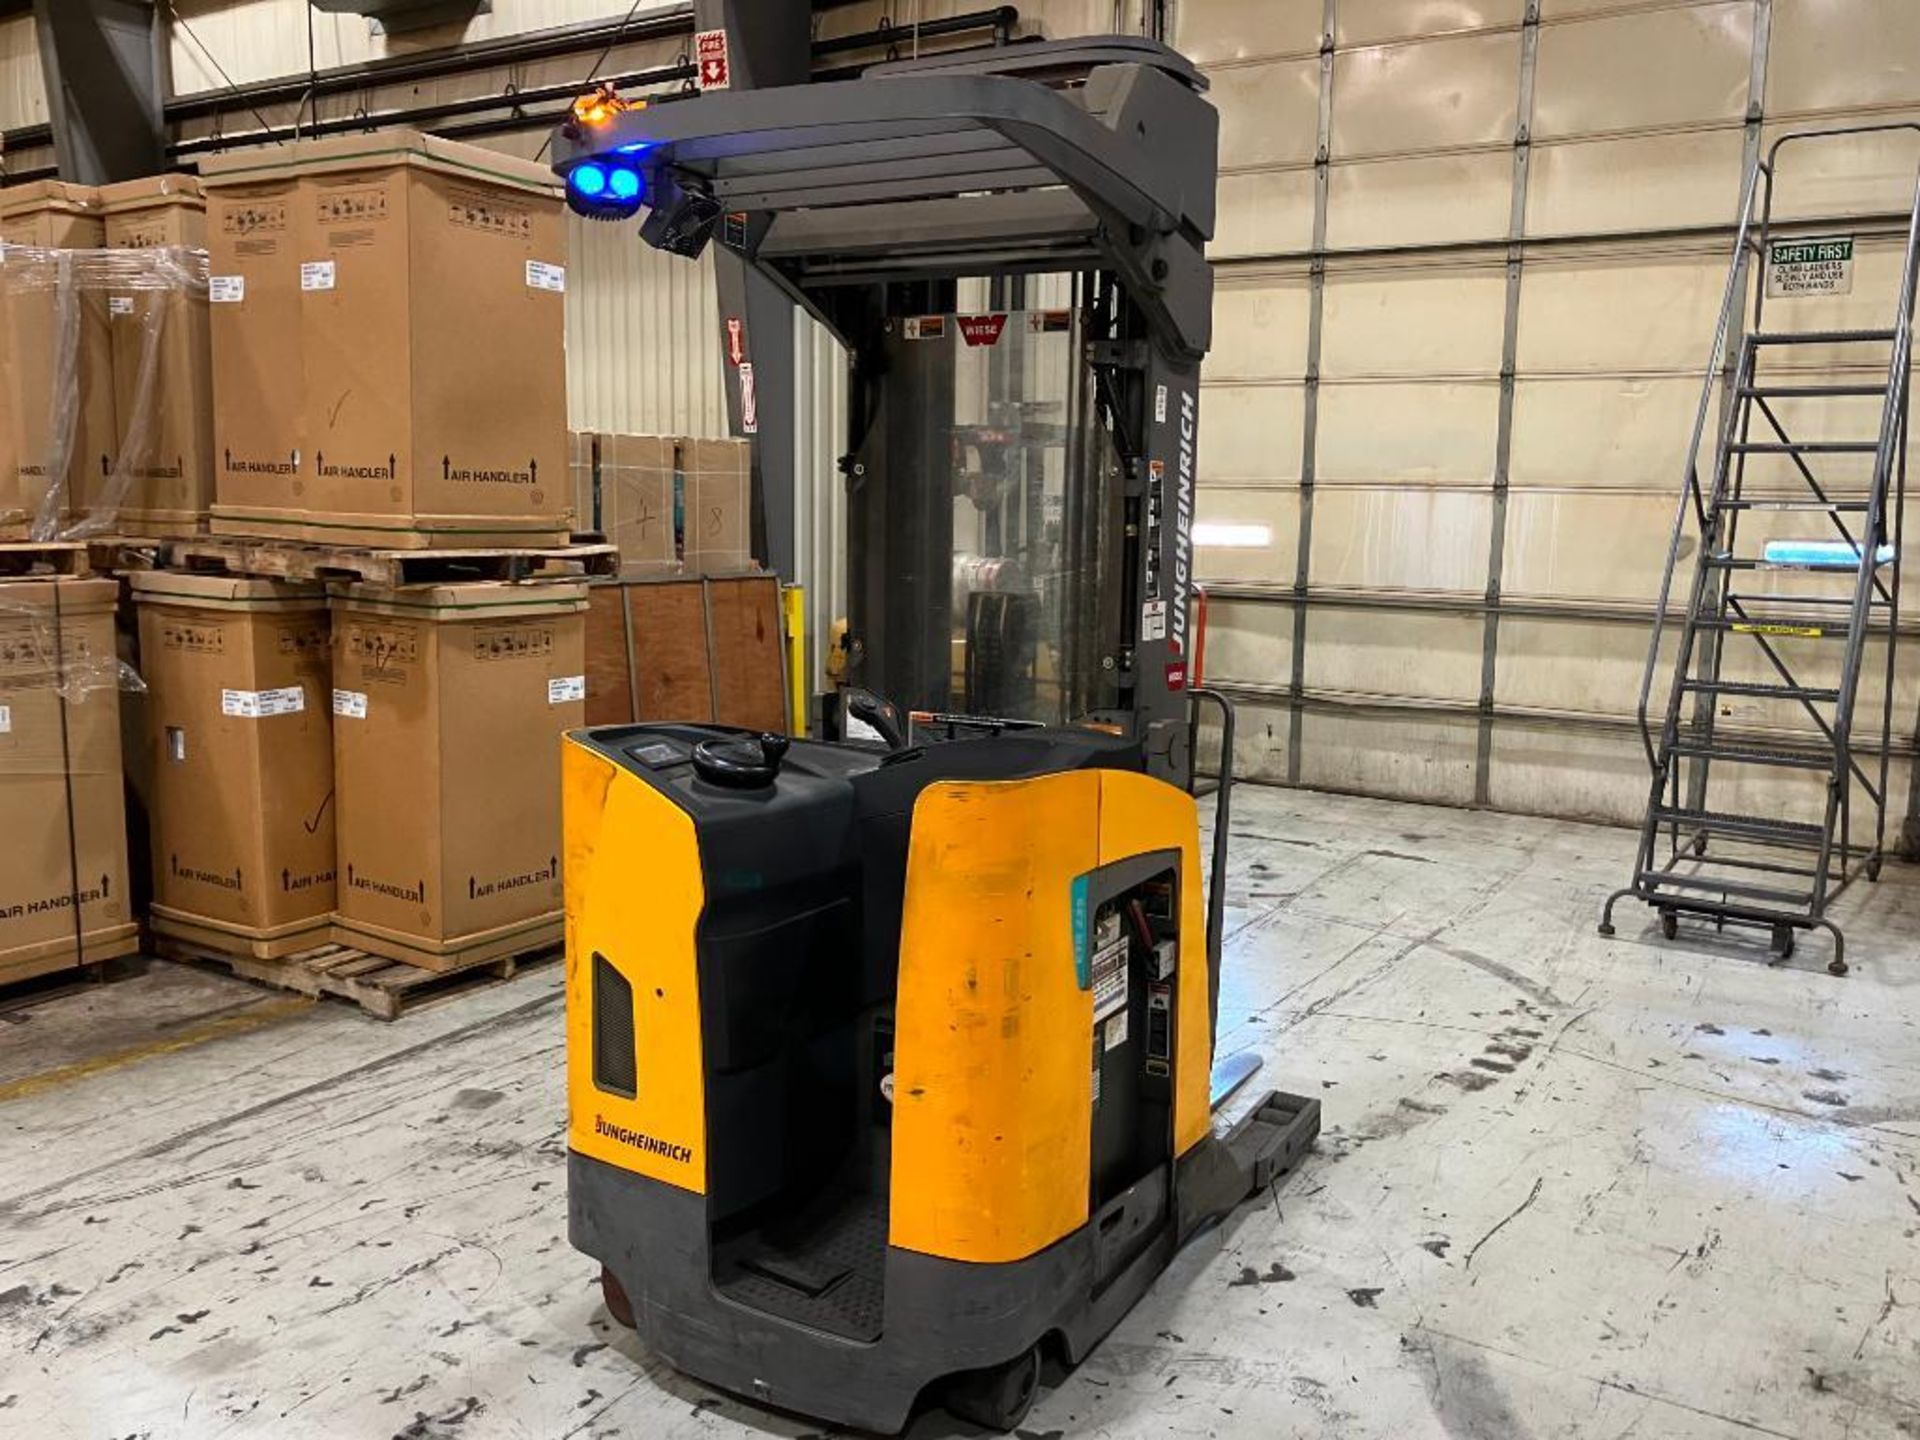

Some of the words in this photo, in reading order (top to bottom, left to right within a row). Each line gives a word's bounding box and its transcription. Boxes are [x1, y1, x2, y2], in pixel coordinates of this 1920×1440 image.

[1773, 246, 1816, 263] SAFETY
[1818, 243, 1850, 259] FIRST
[965, 325, 998, 337] WIESE
[231, 462, 248, 473] AIR
[249, 463, 292, 475] HANDLER
[323, 466, 340, 477] AIR
[341, 466, 389, 480] HANDLER
[450, 470, 471, 481] AIR
[473, 471, 529, 484] HANDLER
[1169, 389, 1194, 656] JUNGHEINRICH
[196, 873, 237, 889] HANDLER
[291, 875, 313, 890] AIR
[476, 882, 495, 898] AIR
[497, 869, 550, 893] HANDLER
[354, 878, 371, 891] AIR
[373, 883, 419, 903] HANDLER
[0, 905, 24, 919] AIR
[594, 1114, 692, 1163] JUNGHEINRICH
